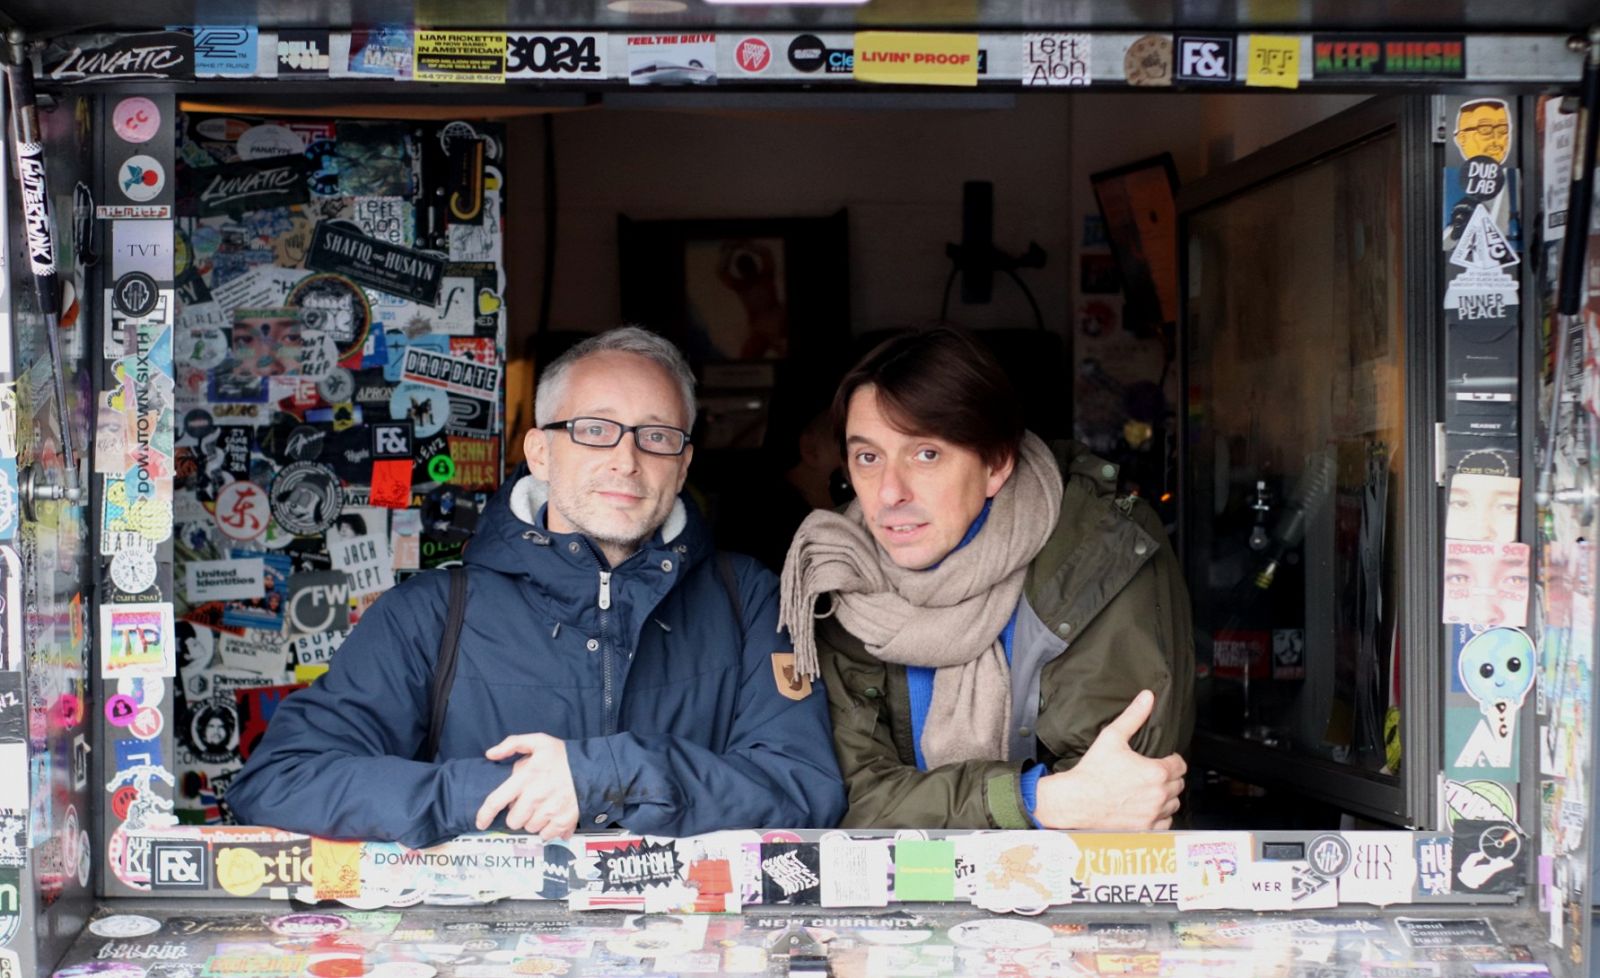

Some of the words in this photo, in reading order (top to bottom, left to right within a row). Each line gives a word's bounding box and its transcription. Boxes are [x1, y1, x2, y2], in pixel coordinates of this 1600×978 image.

[419, 34, 446, 42] LIAM
[448, 34, 503, 42] RICKETTS
[627, 35, 653, 46] FEEL
[431, 46, 504, 55] AMSTERDAM
[1029, 36, 1078, 64] Left
[1315, 41, 1381, 74] KEEP
[1385, 41, 1463, 74] HUSH
[50, 45, 184, 80] LUNATIC
[861, 51, 911, 64] LIVIN'
[913, 52, 971, 65] PROOF
[1468, 161, 1498, 179] DUB
[201, 166, 299, 202] LUNATIC
[1465, 178, 1497, 194] LAB
[126, 244, 161, 257] TVT
[322, 232, 373, 265] SHAFIQ
[384, 251, 436, 282] HUSAYN
[1458, 293, 1504, 308] INNER
[1458, 304, 1507, 320] PEACE
[136, 331, 150, 386] SIXTH
[406, 350, 498, 392] DROPDATE
[136, 389, 150, 494] DOWNTOWN
[451, 441, 494, 462] BENNY
[195, 568, 237, 579] United
[196, 576, 256, 588] Identities
[212, 674, 274, 685] Dimension
[374, 852, 479, 867] DOWNTOWN
[483, 854, 536, 869] SIXTH
[812, 918, 921, 928] CURRENCY
[1406, 922, 1444, 930] Seoul
[1410, 929, 1486, 938] Community
[1413, 936, 1452, 944] Radio
